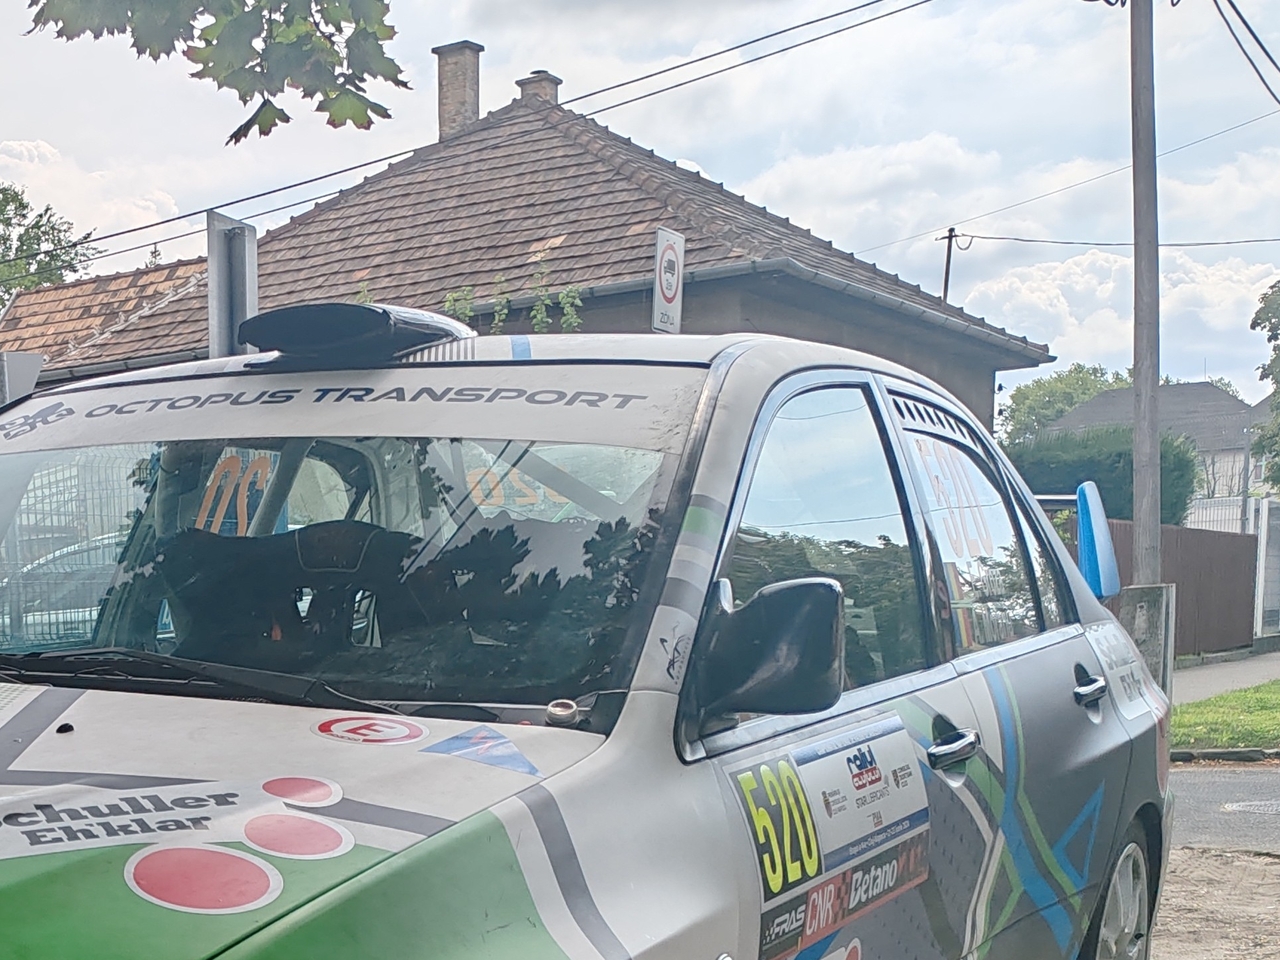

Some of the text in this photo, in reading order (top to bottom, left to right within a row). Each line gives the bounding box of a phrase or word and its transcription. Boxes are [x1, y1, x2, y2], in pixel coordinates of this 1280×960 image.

[85, 386, 649, 418] OCTOPUS TRANSPORT
[736, 760, 819, 894] 520
[772, 859, 898, 939] FRAS CNR Betano
